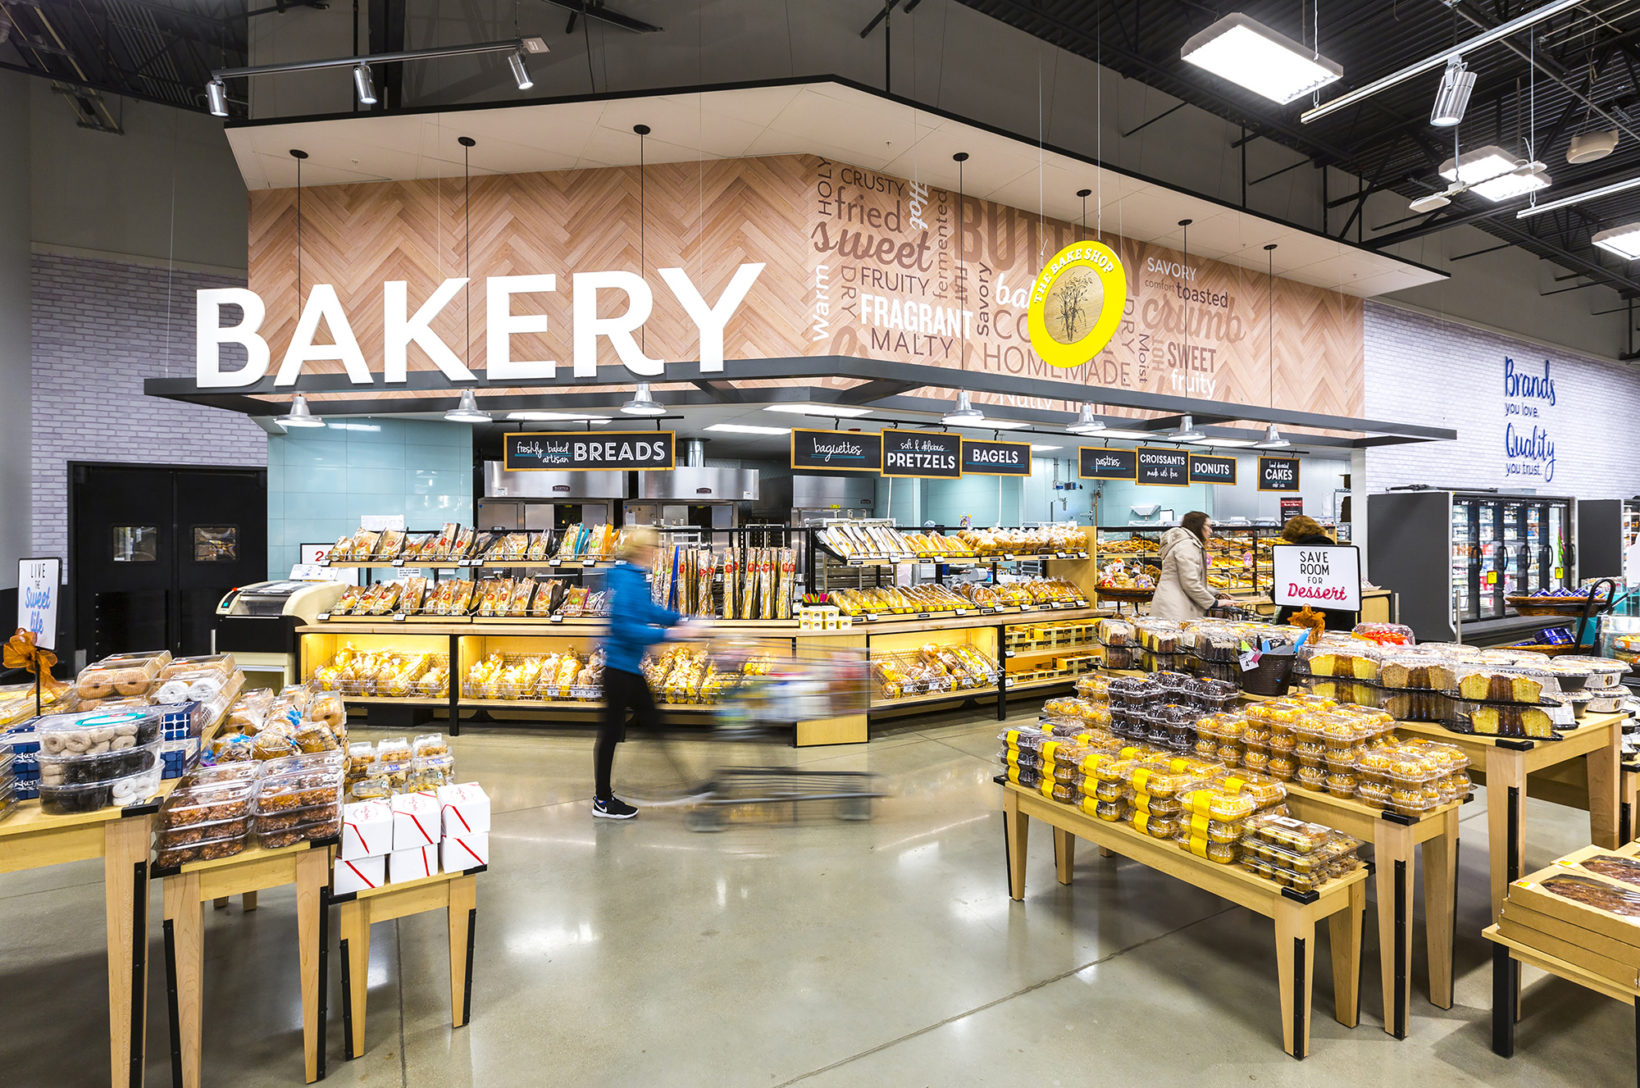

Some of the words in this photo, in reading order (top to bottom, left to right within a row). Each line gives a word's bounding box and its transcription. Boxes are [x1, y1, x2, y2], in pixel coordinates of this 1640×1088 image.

[818, 156, 832, 216] HOLY
[841, 167, 905, 195] CRUSTY
[834, 186, 903, 234] fried
[811, 221, 934, 273] sweet
[932, 189, 948, 301] fermented
[861, 267, 930, 297] FRUITY
[1034, 273, 1051, 304] THE
[1050, 249, 1083, 275] BAKE
[1084, 248, 1114, 273] SHOP
[1147, 256, 1197, 281] SAVORY
[841, 265, 857, 319] DRY
[1176, 282, 1229, 308] toasted
[196, 262, 767, 388] BAKERY
[860, 293, 974, 340] FRAGRANT
[1141, 294, 1247, 345] crumb
[871, 327, 954, 359] MALTY
[1168, 341, 1217, 373] SWEET
[1171, 369, 1216, 398] fruity
[1504, 355, 1556, 406] Brands
[1504, 402, 1520, 416] you
[573, 441, 665, 461] BREADS
[813, 437, 863, 462] baguettes
[887, 452, 956, 469] PRETZELS
[972, 449, 1019, 464] BAGELS
[1139, 454, 1186, 466] CROISSANTS
[1505, 422, 1557, 483] Quality
[1194, 463, 1230, 475] DONUTS
[1265, 468, 1293, 480] CAKES
[1505, 462, 1521, 477] you
[1299, 551, 1329, 563] SAVE
[1300, 563, 1330, 575] ROOM
[1287, 582, 1348, 600] Dessert
[1307, 576, 1323, 584] FOR
[25, 586, 51, 609] Sweet
